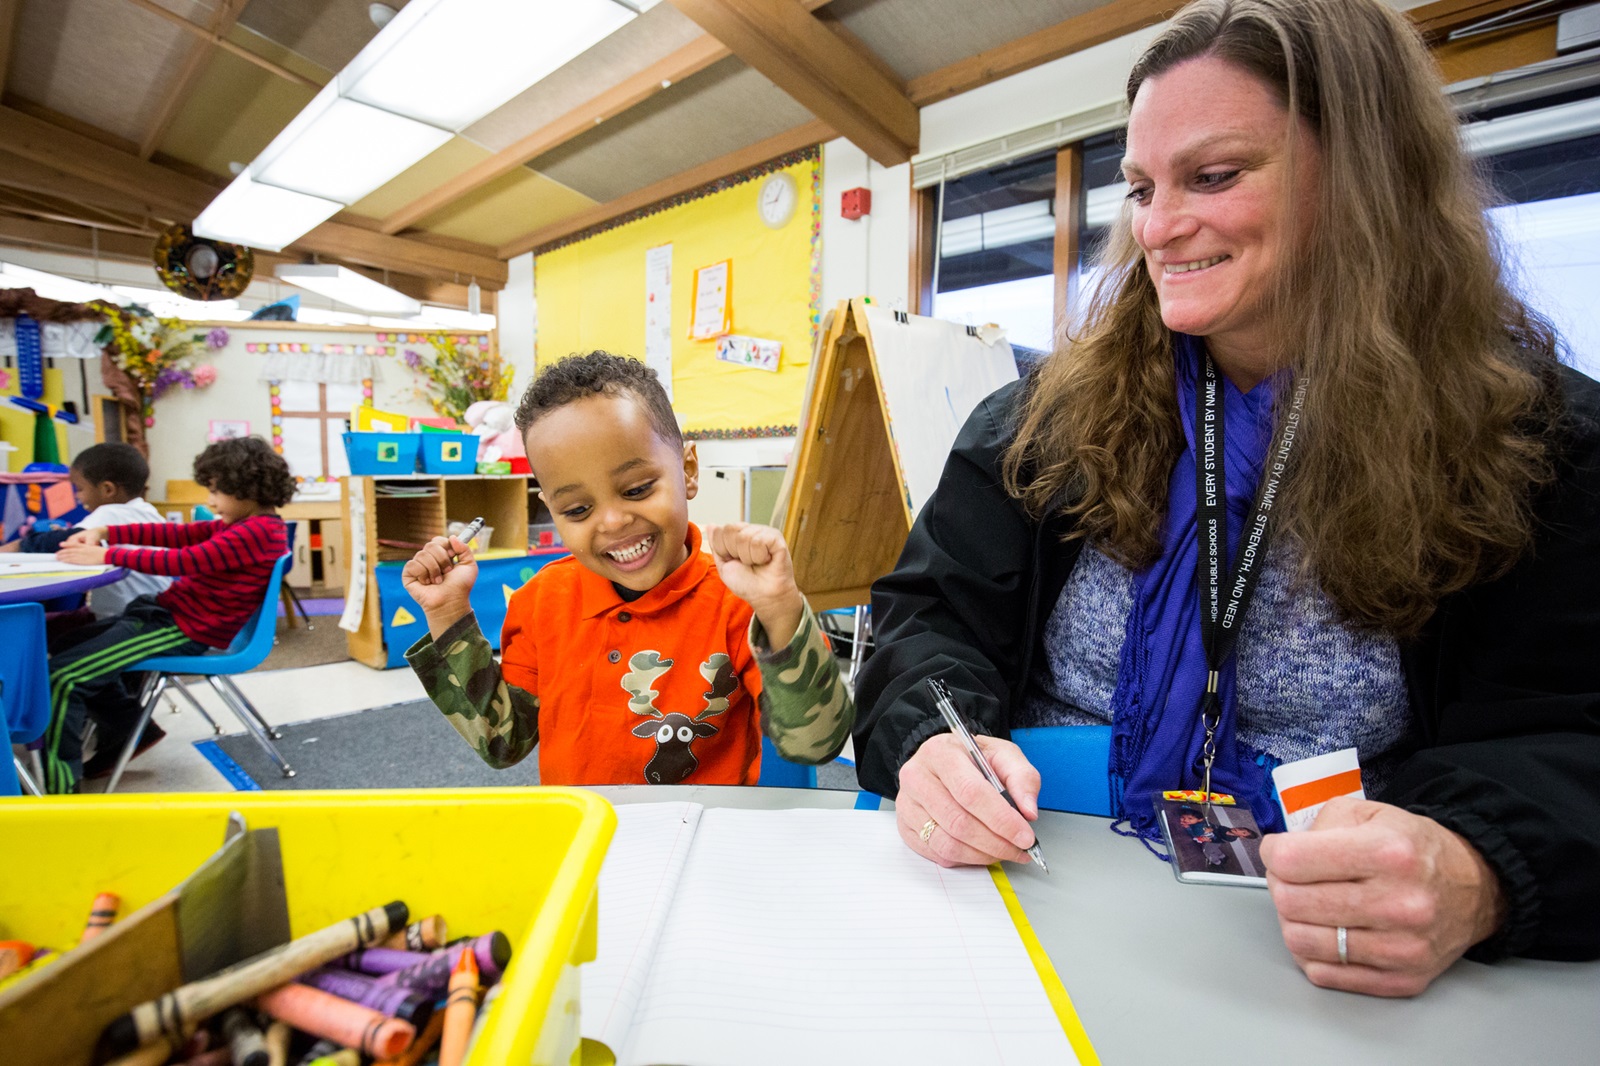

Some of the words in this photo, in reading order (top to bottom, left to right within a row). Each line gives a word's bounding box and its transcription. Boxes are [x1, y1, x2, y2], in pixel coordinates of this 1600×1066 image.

[1205, 379, 1217, 406] NAME,
[1292, 377, 1310, 412] EVERY
[1204, 408, 1215, 422] BY
[1204, 423, 1216, 470] STUDENT
[1277, 412, 1300, 462] STUDENT
[1272, 462, 1285, 479] BY
[1205, 472, 1216, 507] EVERY
[1258, 479, 1280, 512] NAME,
[1208, 518, 1218, 556] SCHOOLS
[1238, 513, 1268, 573] STRENGTH,
[1209, 557, 1218, 585] PUBLIC
[1231, 574, 1247, 599] AND
[1210, 586, 1219, 623] HIGHLINE
[1222, 599, 1240, 629] NEED
